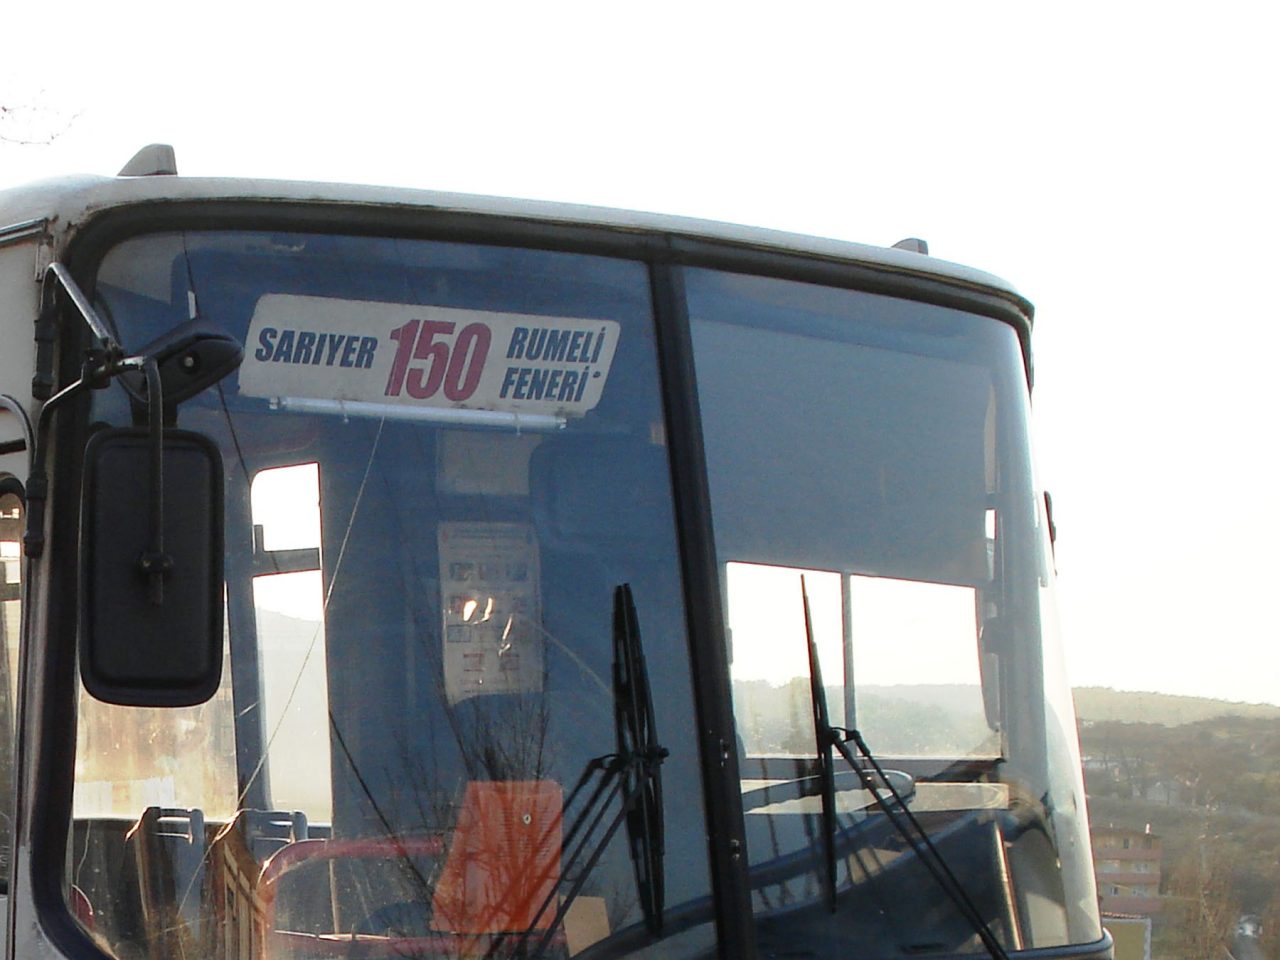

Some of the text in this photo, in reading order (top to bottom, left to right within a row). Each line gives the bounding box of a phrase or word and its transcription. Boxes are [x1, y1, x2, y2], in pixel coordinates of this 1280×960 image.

[255, 326, 379, 370] SARIYER
[384, 318, 493, 402] 150
[506, 326, 607, 365] RUMELİ
[499, 365, 590, 403] FENERİ
